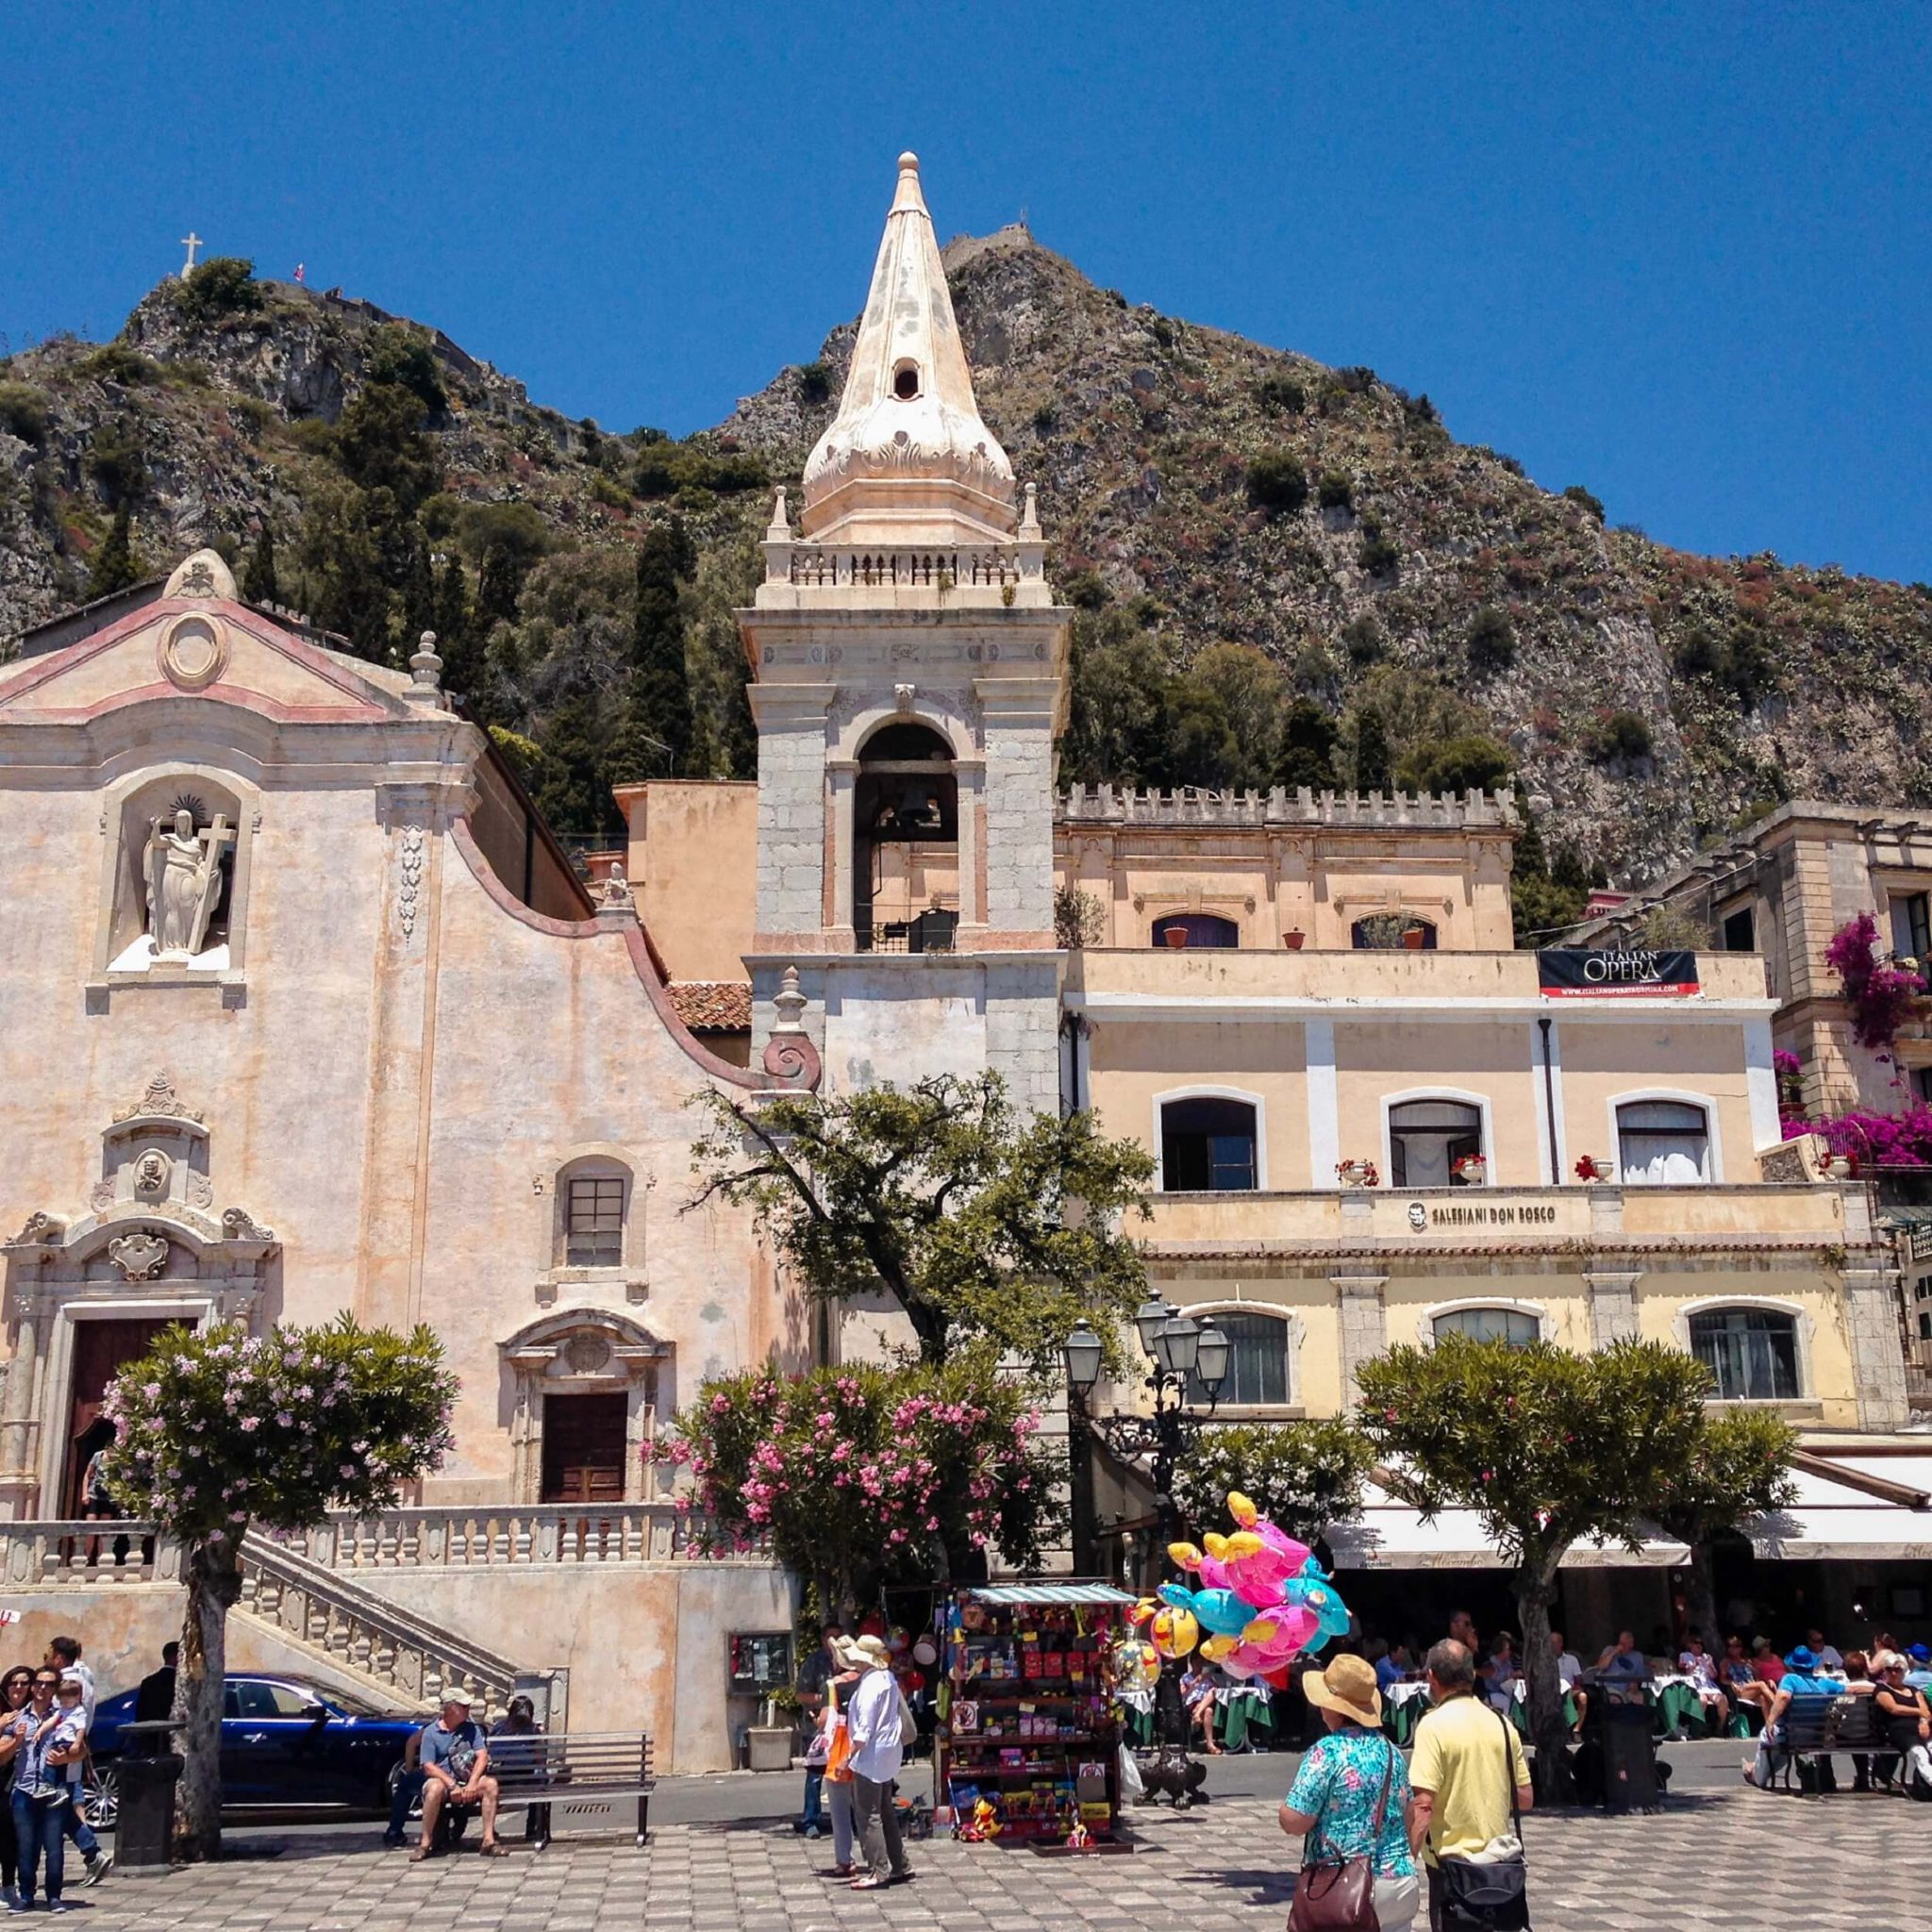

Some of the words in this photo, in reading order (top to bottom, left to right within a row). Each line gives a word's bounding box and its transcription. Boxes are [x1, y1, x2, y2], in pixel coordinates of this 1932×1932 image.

[1603, 950, 1660, 961] ITALIAN
[1584, 958, 1661, 981] OPERA
[1432, 1208, 1487, 1225] SALESIANI
[1490, 1208, 1515, 1224] DON
[1518, 1206, 1556, 1224] BOSCO
